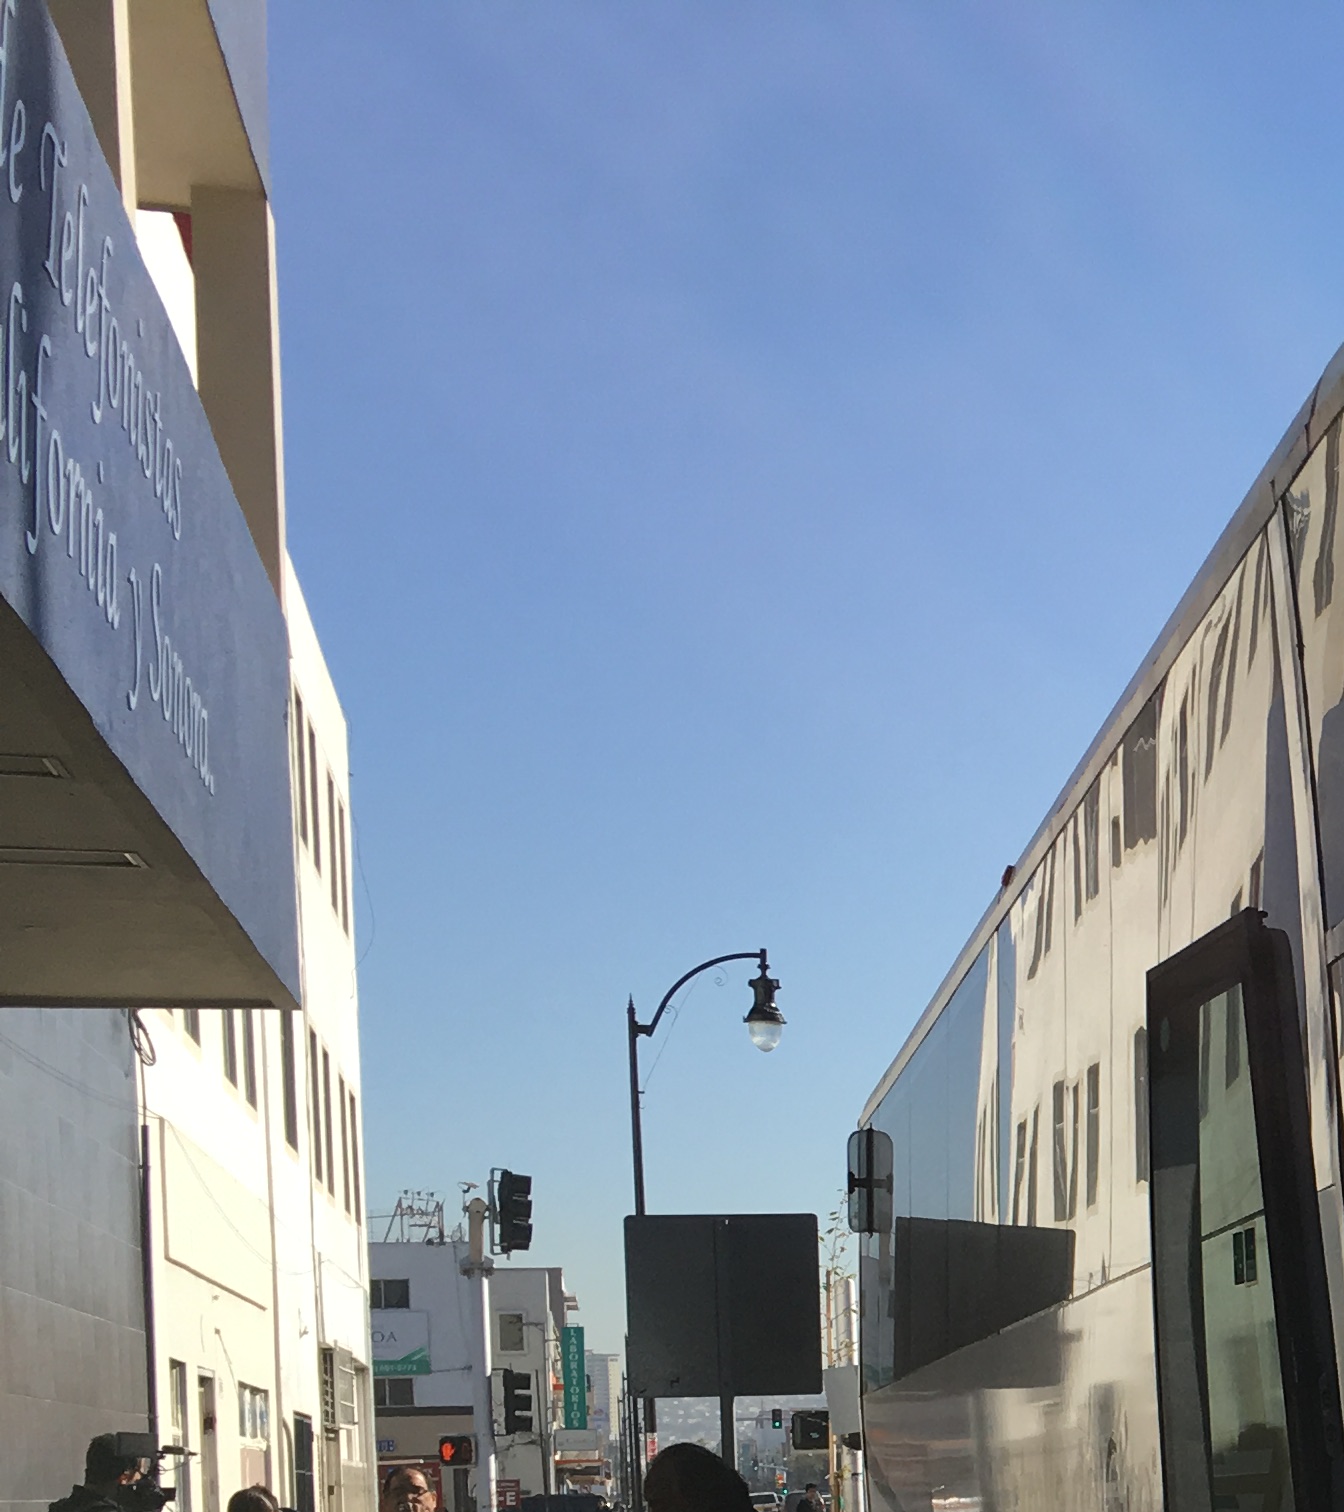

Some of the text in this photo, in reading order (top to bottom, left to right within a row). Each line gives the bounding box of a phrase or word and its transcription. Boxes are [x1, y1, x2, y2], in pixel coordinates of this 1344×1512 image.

[0, 282, 120, 630] lifornia
[128, 566, 142, 711] y
[40, 122, 182, 541] Telefonistas
[569, 1328, 580, 1428] LABORATORIOS
